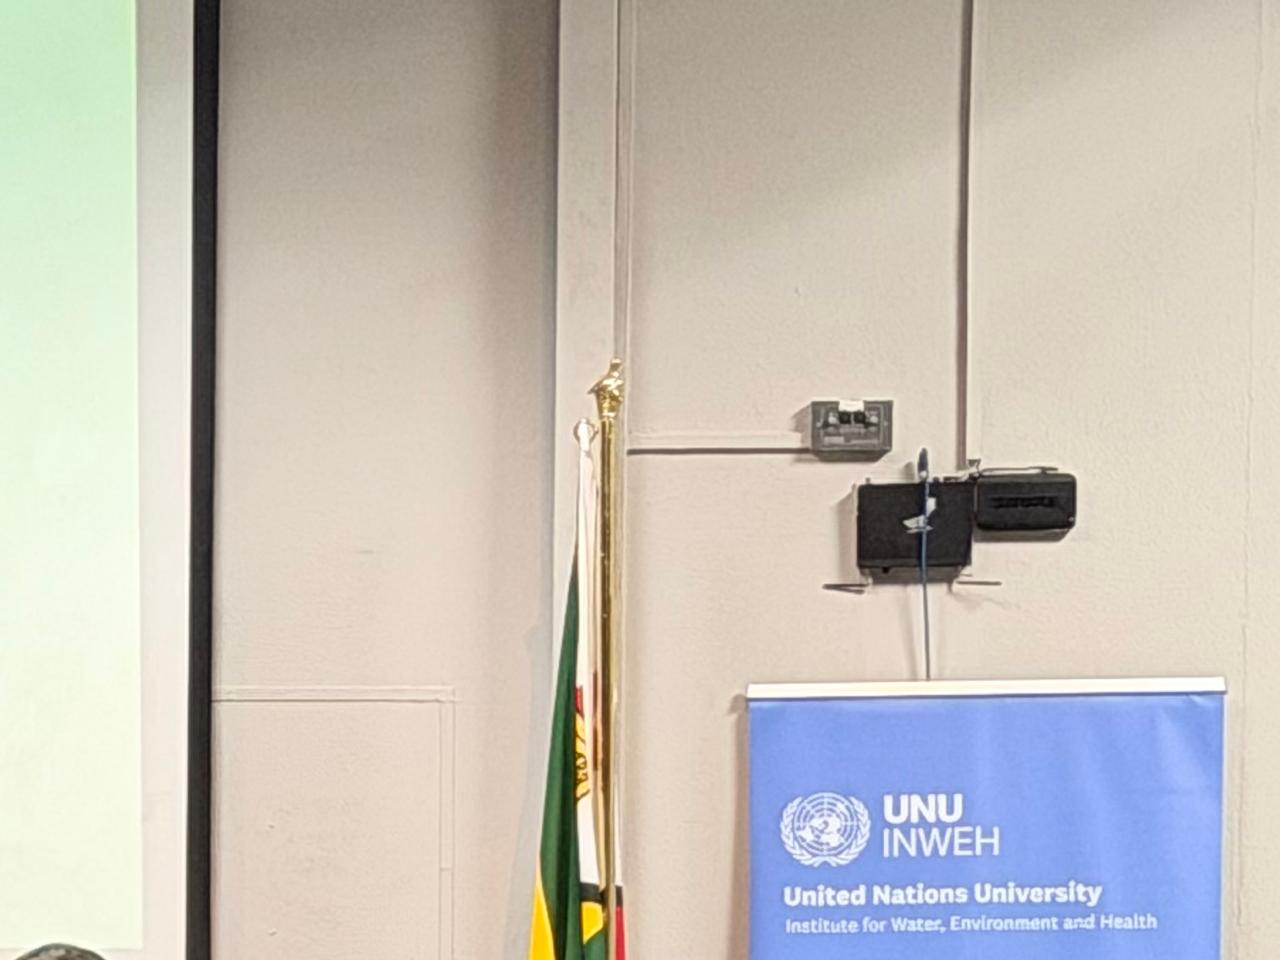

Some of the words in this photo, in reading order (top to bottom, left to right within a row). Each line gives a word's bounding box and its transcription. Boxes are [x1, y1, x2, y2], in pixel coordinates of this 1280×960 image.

[883, 793, 963, 824] UNU
[883, 825, 1000, 858] INWEH
[783, 884, 867, 907] United
[872, 882, 969, 906] Nations
[974, 879, 1103, 908] University
[785, 917, 860, 934] Institute
[862, 916, 888, 933] for
[890, 916, 947, 934] Water,
[949, 914, 1059, 931] Environment
[1063, 913, 1096, 930] and
[1099, 912, 1158, 930] Health
